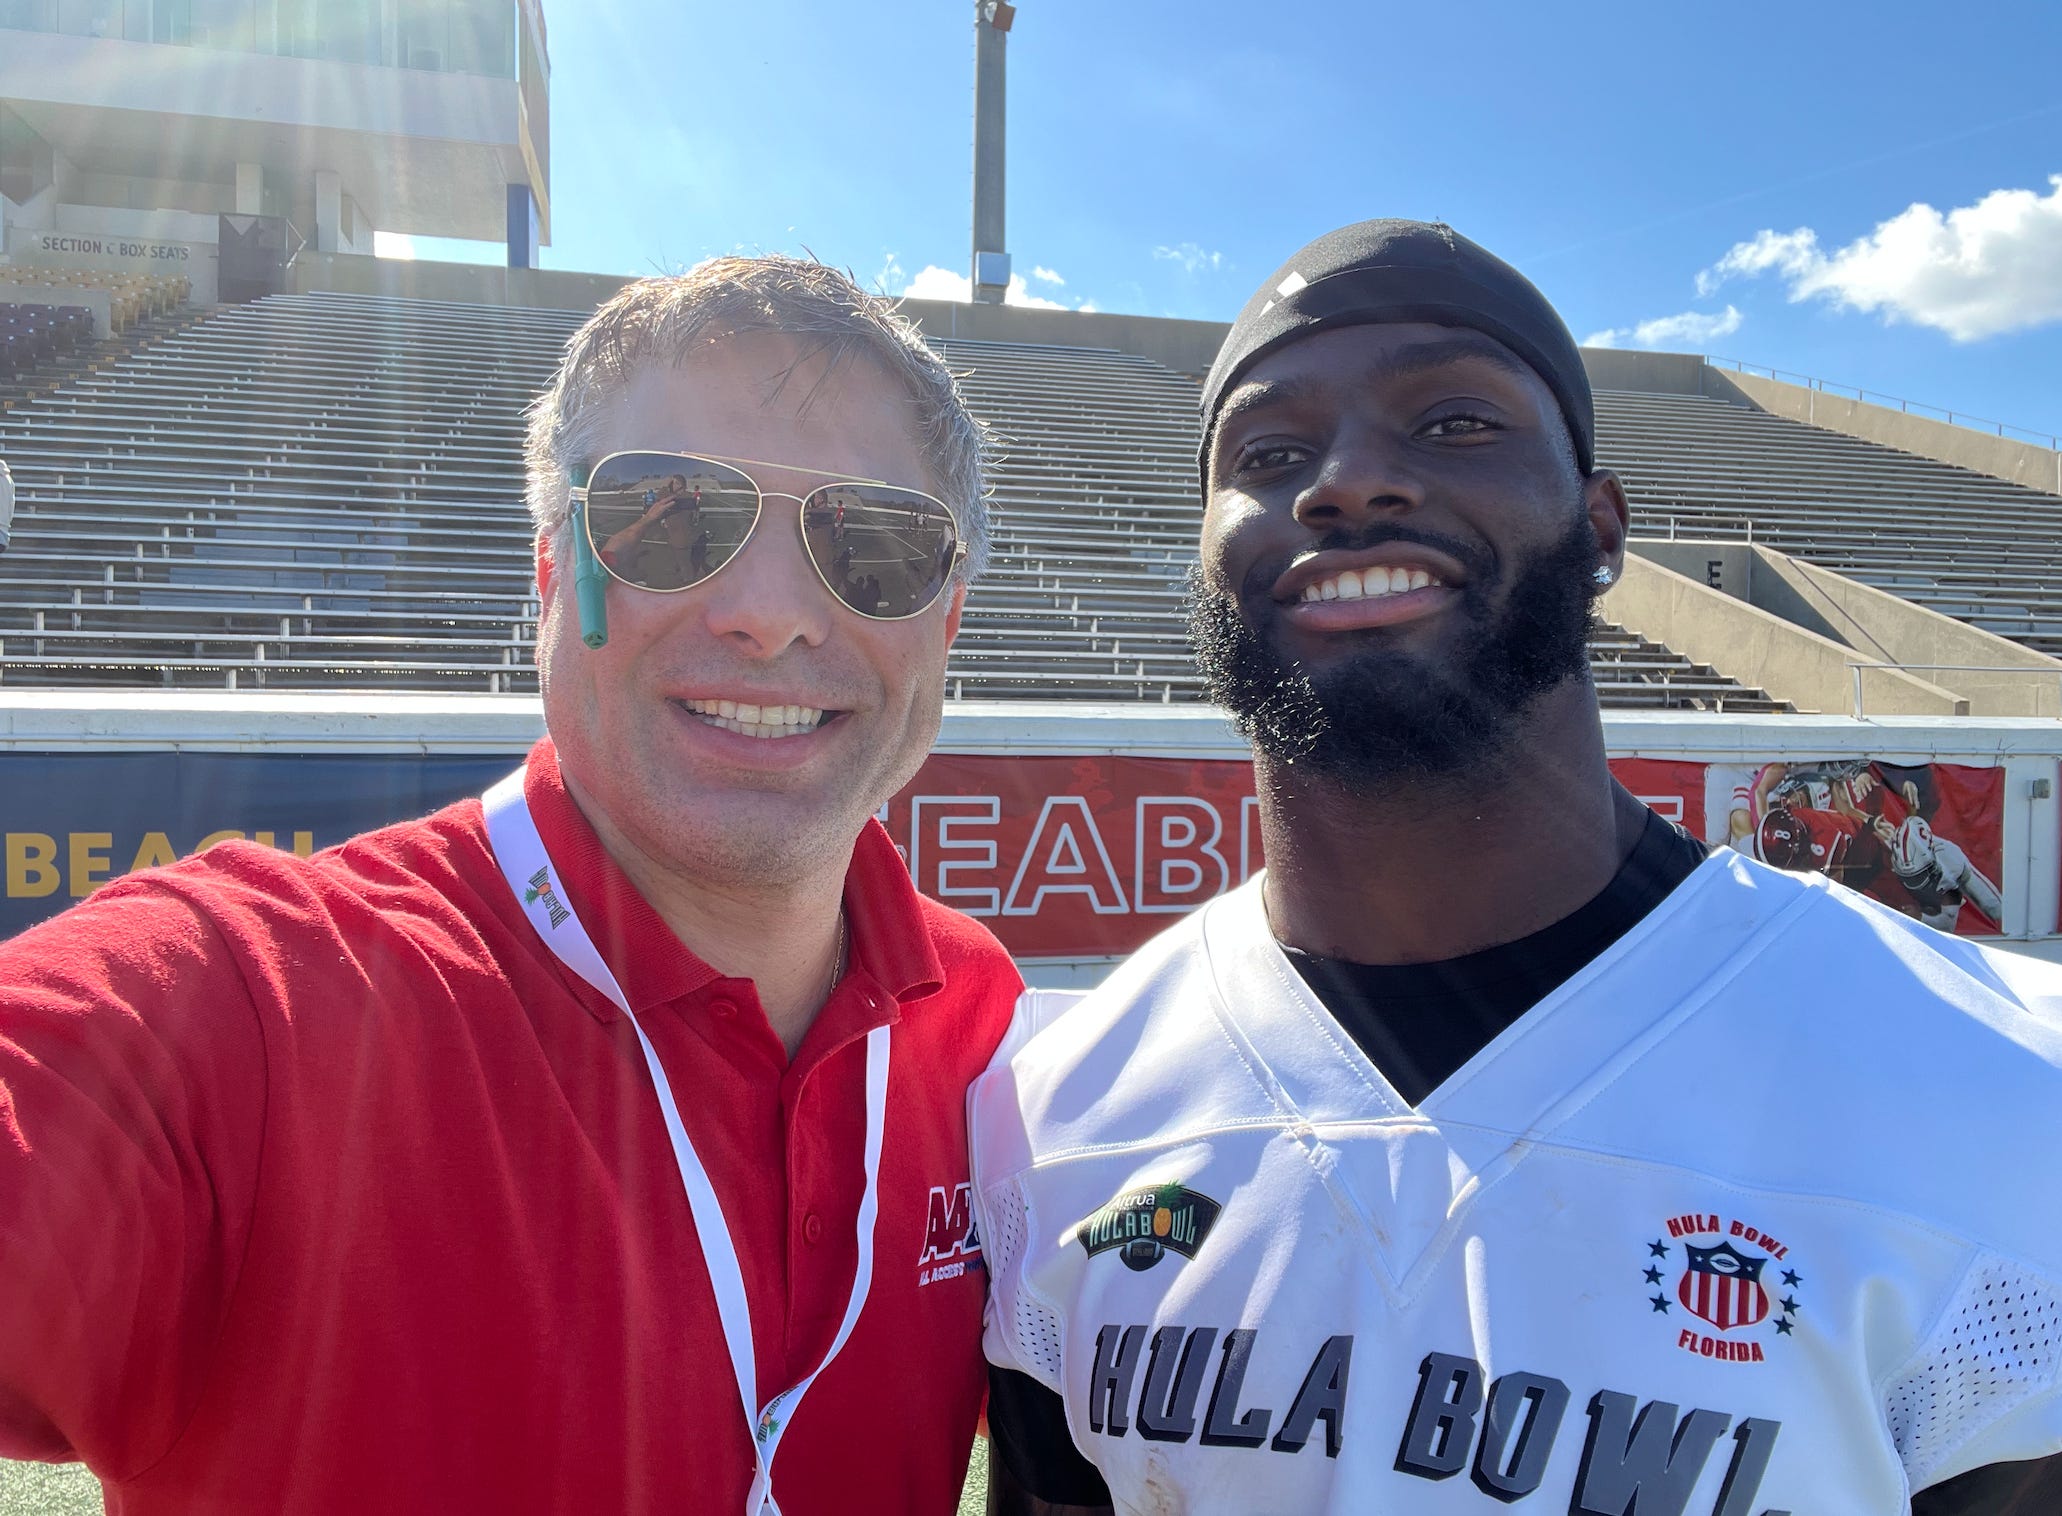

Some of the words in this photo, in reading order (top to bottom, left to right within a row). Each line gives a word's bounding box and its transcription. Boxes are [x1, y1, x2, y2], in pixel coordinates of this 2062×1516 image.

[42, 236, 102, 254] SECTION
[119, 243, 147, 257] BOX
[150, 246, 190, 261] SEATS
[1707, 560, 1723, 589] E
[6, 830, 313, 898] BEA
[1666, 1214, 1721, 1238] HULA
[1729, 1219, 1790, 1261] BOWL
[1677, 1328, 1765, 1362] FLORIDA
[1089, 1324, 1355, 1459] HULA
[1393, 1351, 1793, 1516] BOWL
